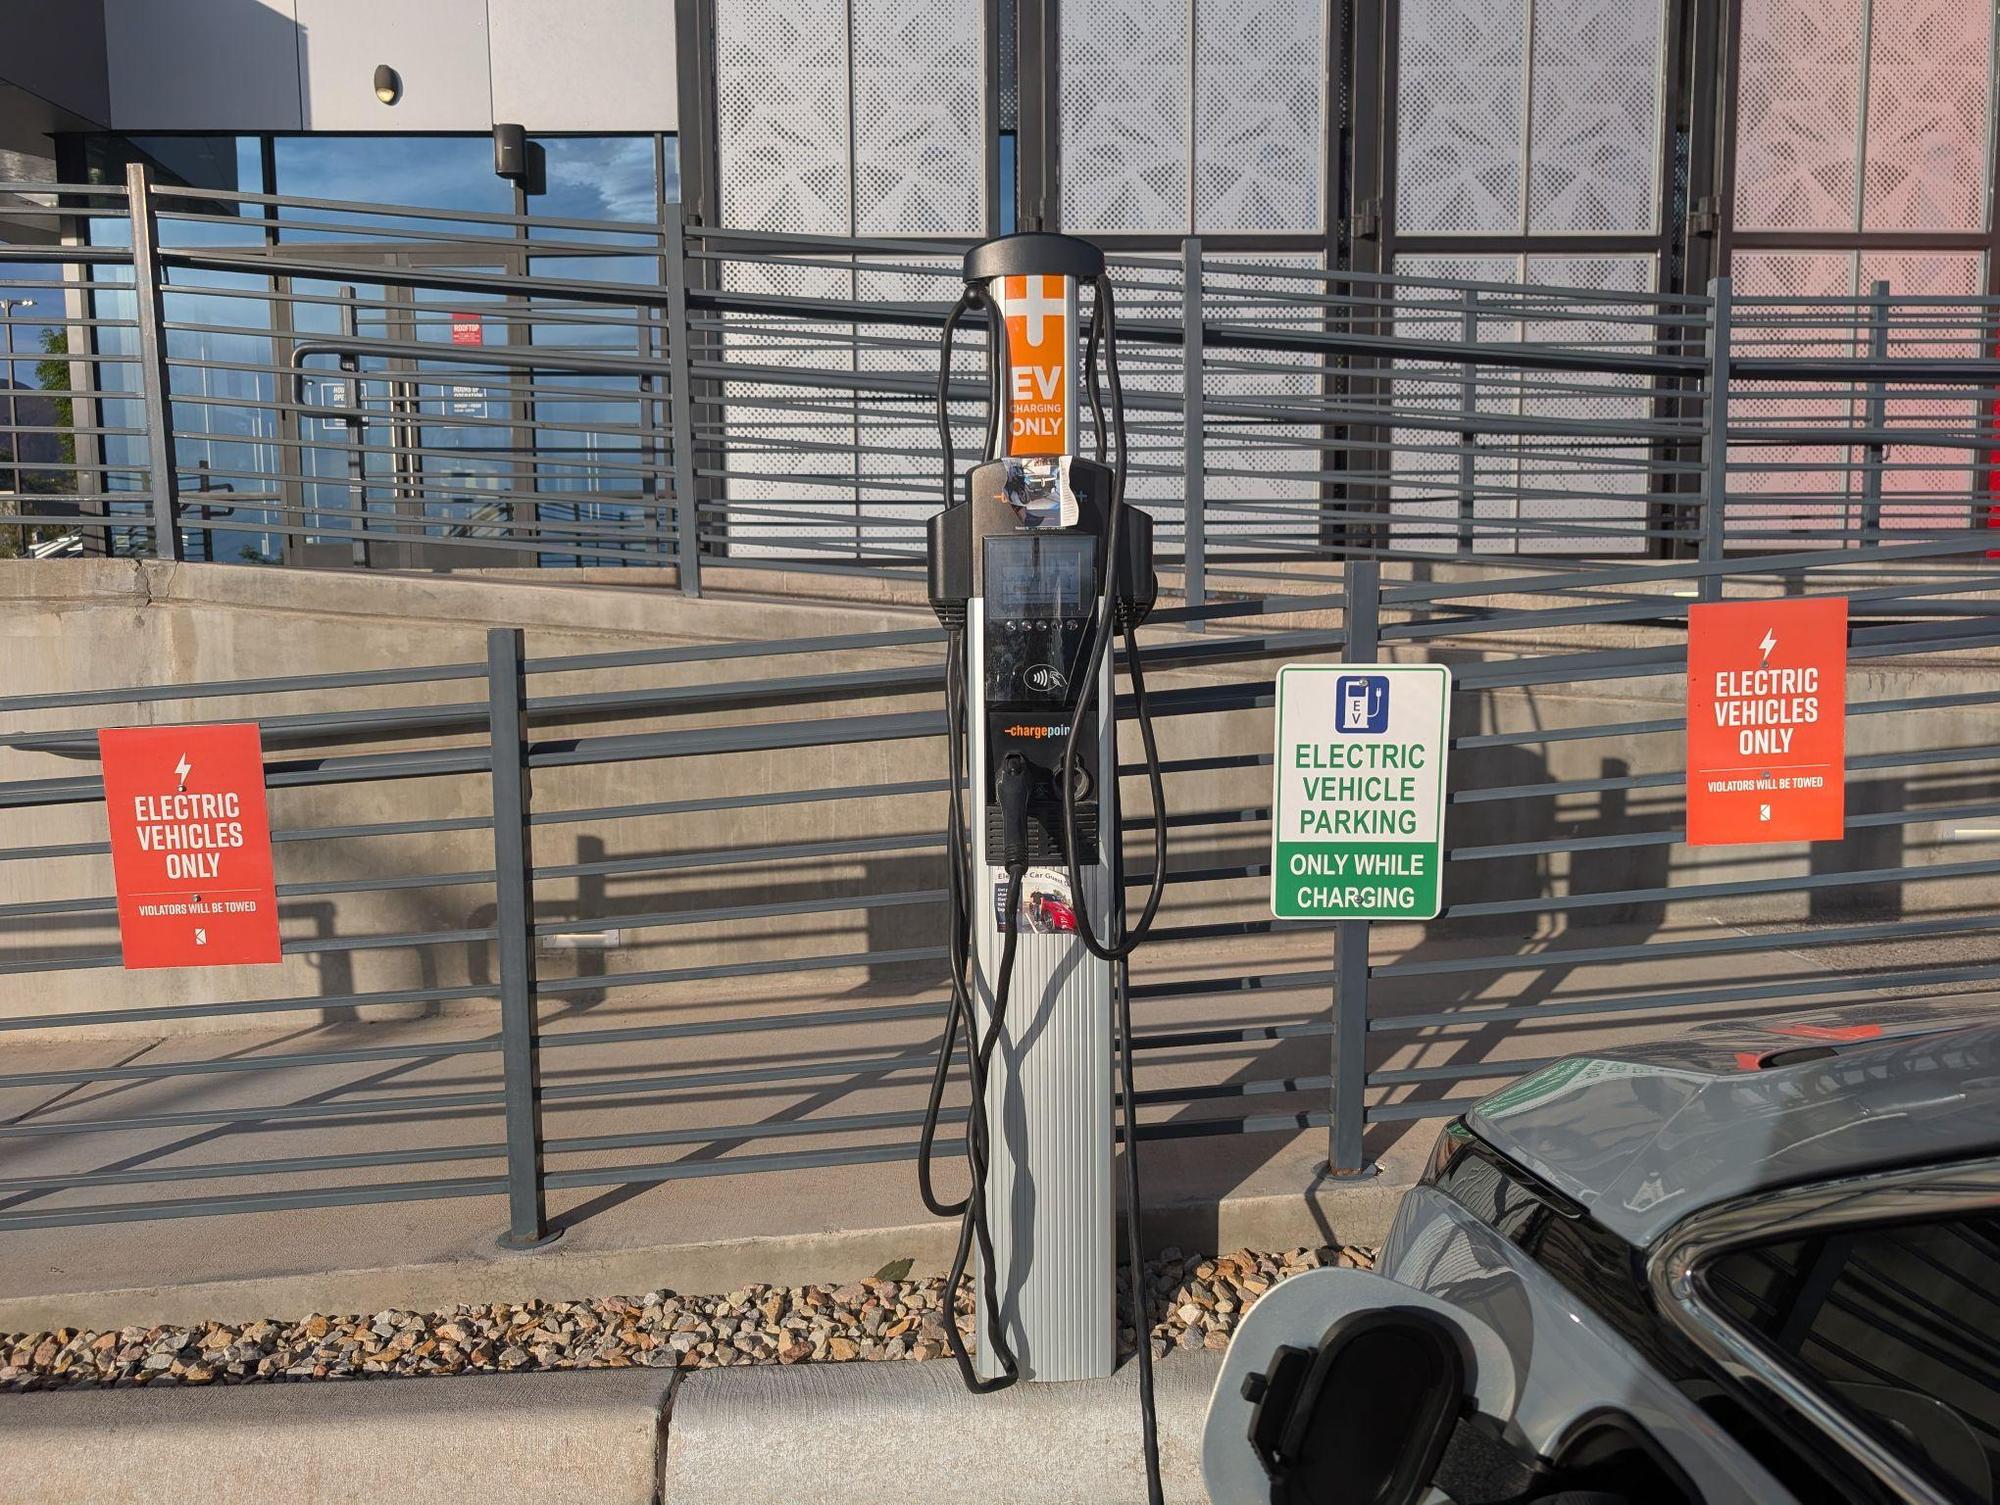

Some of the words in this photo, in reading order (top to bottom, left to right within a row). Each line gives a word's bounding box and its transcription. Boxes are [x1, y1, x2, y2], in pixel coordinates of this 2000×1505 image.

[1011, 366, 1062, 400] EV
[1010, 404, 1061, 414] CHARGING
[1010, 418, 1063, 436] ONLY
[1716, 667, 1818, 698] ELECTRIC
[1715, 697, 1818, 727] VEHICLES
[1739, 727, 1794, 755] ONLY
[1295, 743, 1425, 769] ELECTRIC
[1303, 777, 1416, 802] VEHICLE
[1708, 780, 1755, 792] VIOLATORS
[1756, 778, 1777, 790] WILL
[1779, 777, 1791, 789] BE
[1792, 776, 1823, 789] TOWED
[134, 792, 240, 821] ELECTRIC
[1300, 809, 1417, 835] PARKING
[136, 822, 243, 851] VEHICLES
[166, 852, 220, 879] ONLY
[1289, 854, 1349, 876] ONLY
[1354, 854, 1424, 876] WHILE
[139, 904, 187, 916] VIOLATORS
[188, 903, 210, 914] WILL
[212, 902, 223, 913] BE
[225, 901, 256, 913] TOWED
[1297, 886, 1415, 909] CHARGING
